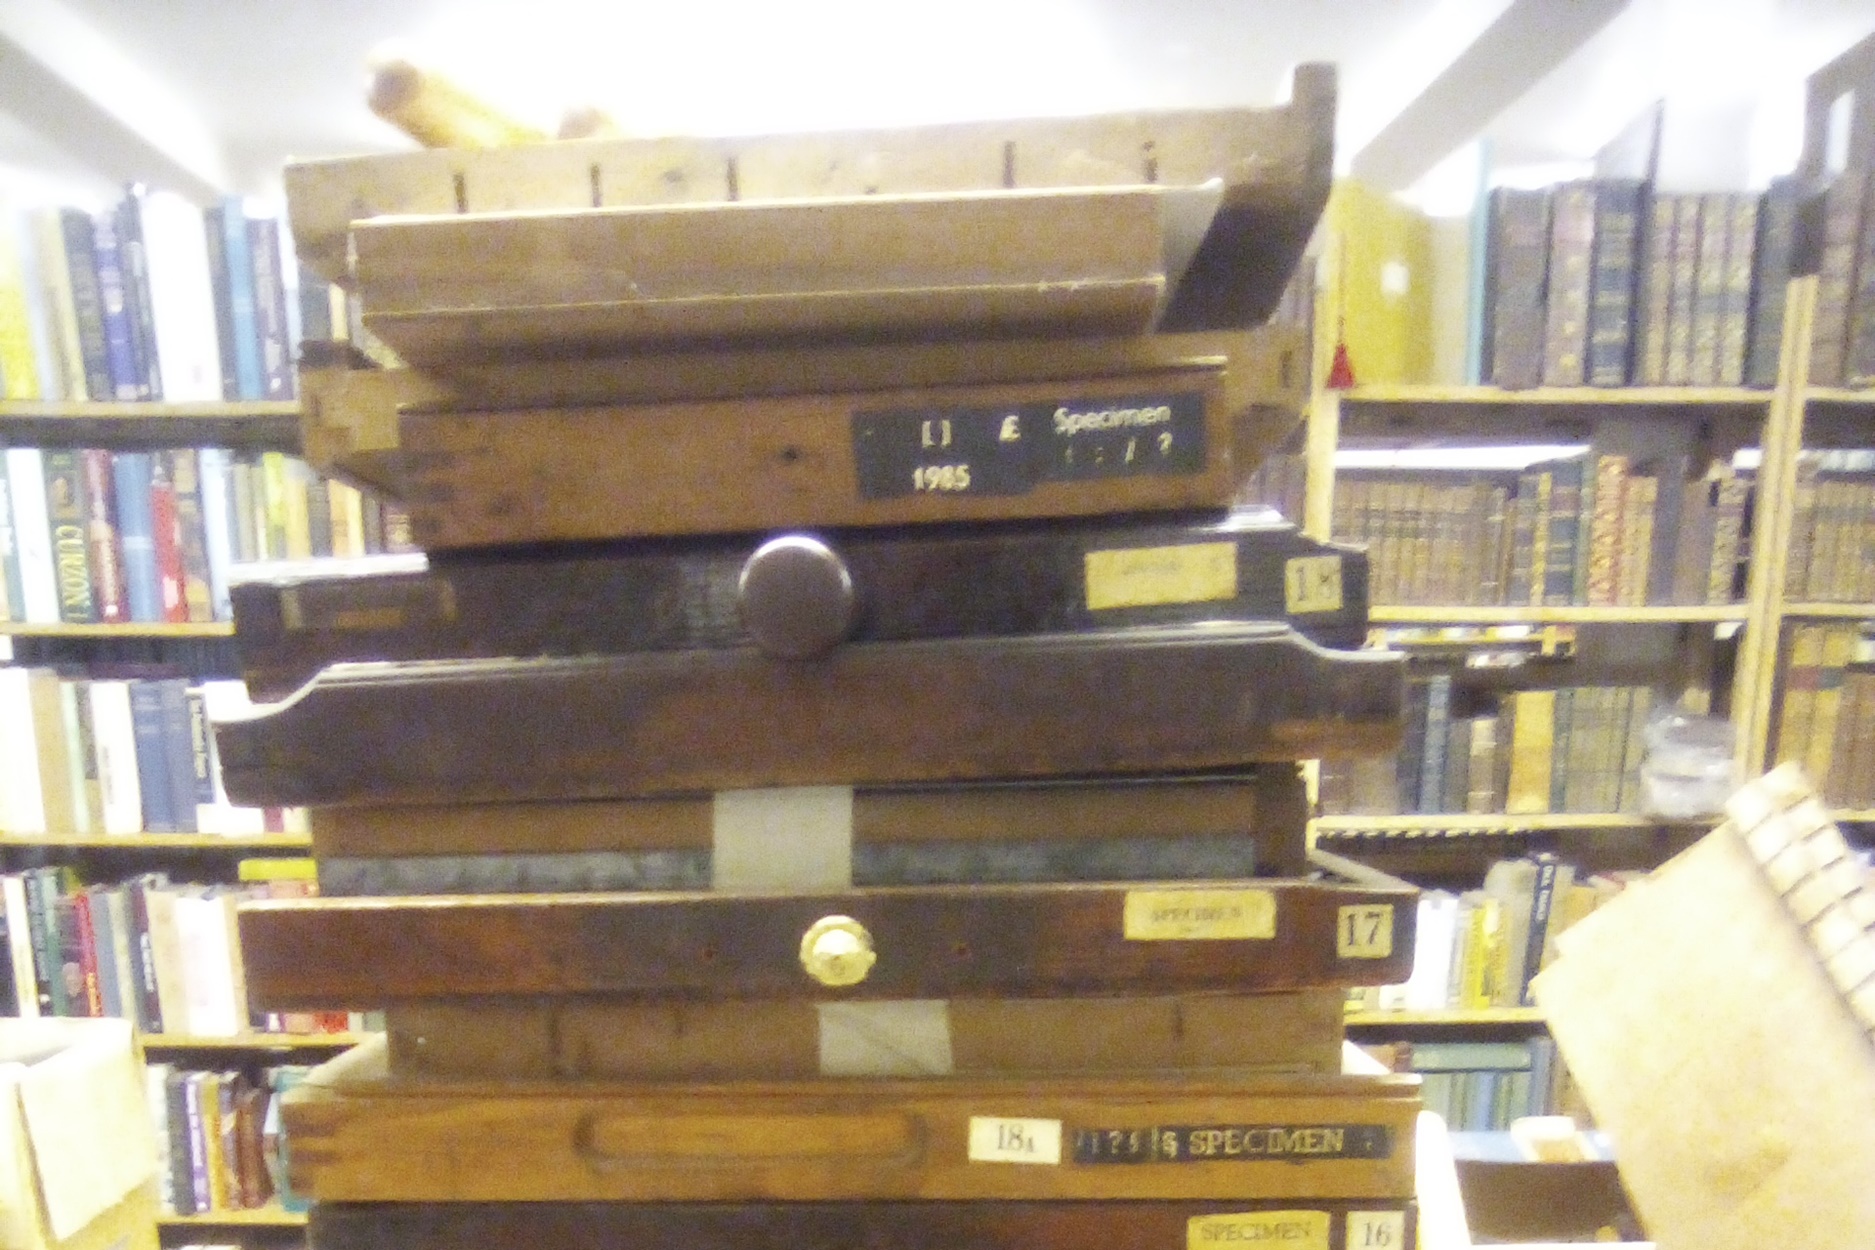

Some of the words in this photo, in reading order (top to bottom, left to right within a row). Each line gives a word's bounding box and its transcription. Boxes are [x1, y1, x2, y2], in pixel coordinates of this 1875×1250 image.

[1053, 405, 1172, 436] Specimen
[912, 463, 972, 493] 1985
[1346, 911, 1384, 946] 17
[1188, 1126, 1345, 1157] SPECIMEN
[1200, 1220, 1312, 1242] SPECIMEN
[1362, 1218, 1392, 1248] 16
